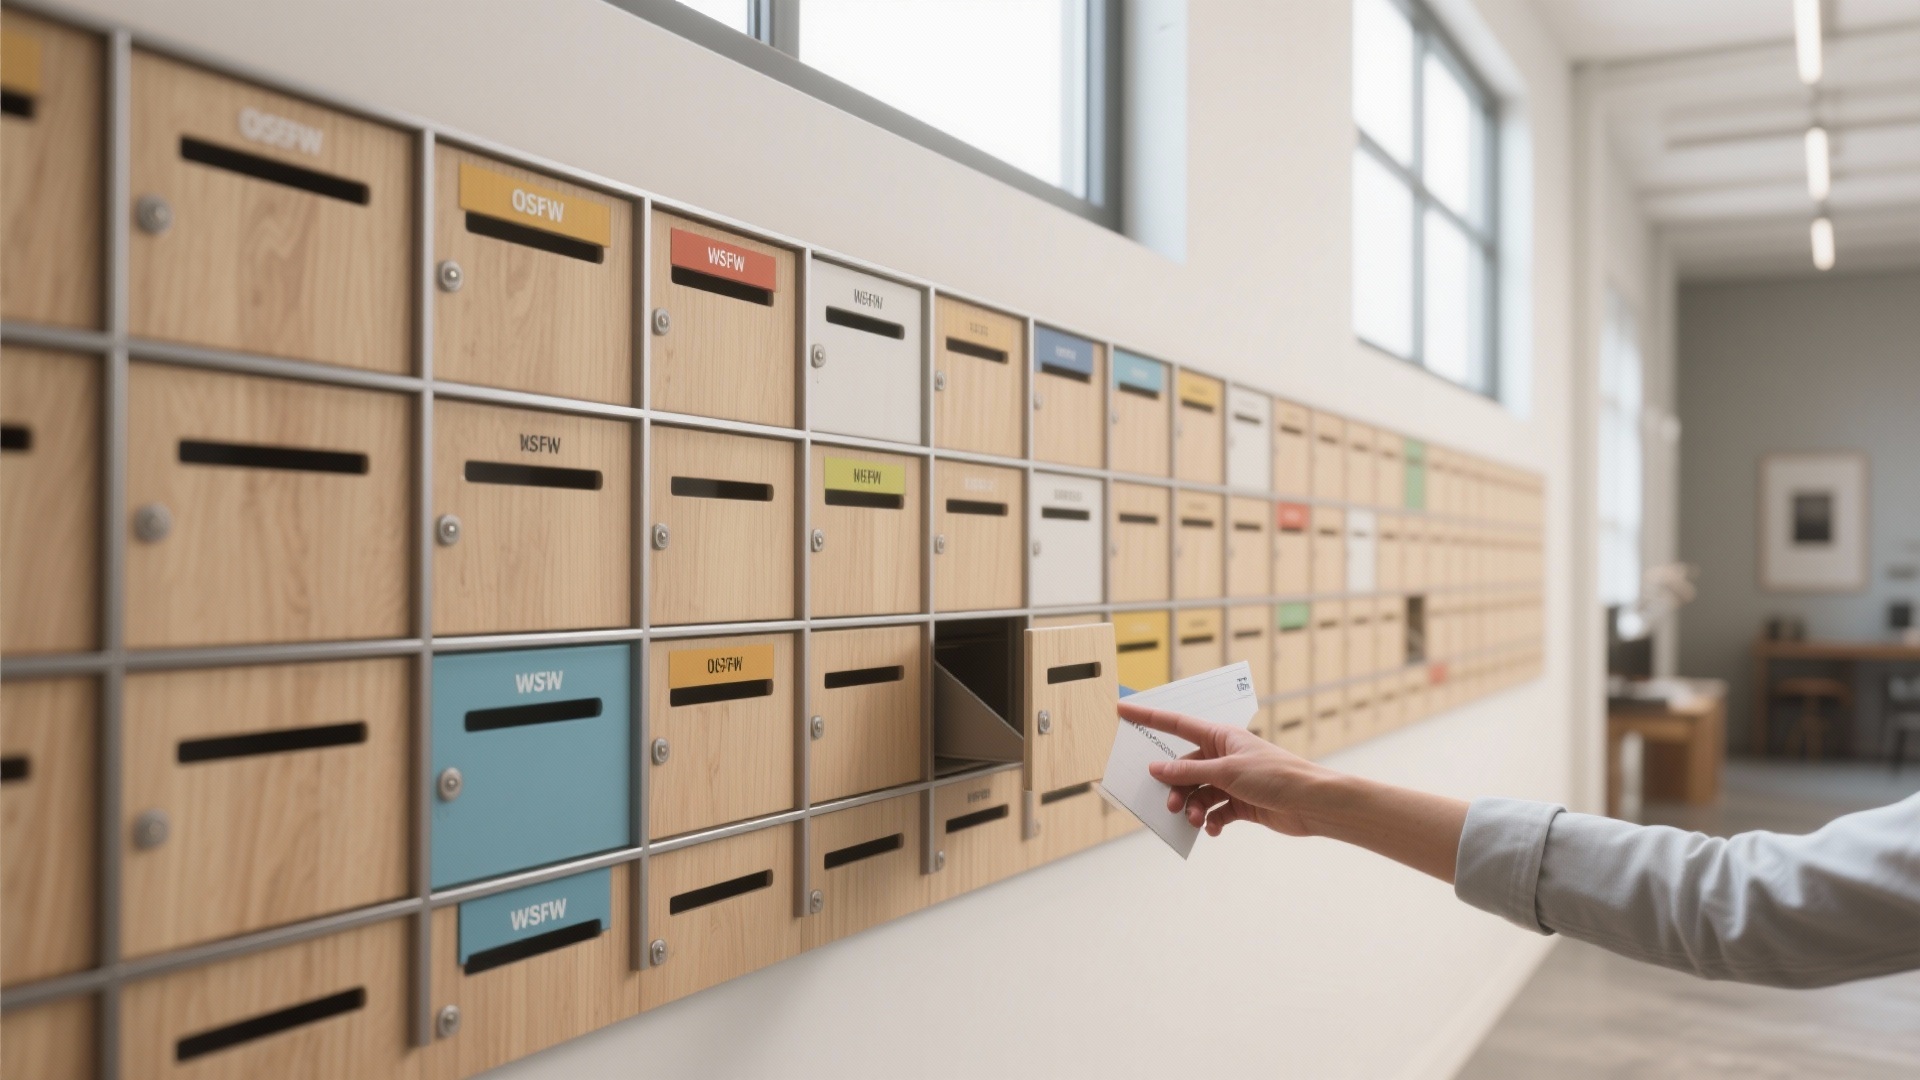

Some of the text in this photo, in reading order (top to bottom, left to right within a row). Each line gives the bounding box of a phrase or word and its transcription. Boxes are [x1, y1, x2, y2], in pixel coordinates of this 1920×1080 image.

[512, 188, 565, 223] OSFW
[707, 246, 745, 273] WSFW
[515, 670, 564, 694] WSW
[510, 897, 567, 931] WSFW
